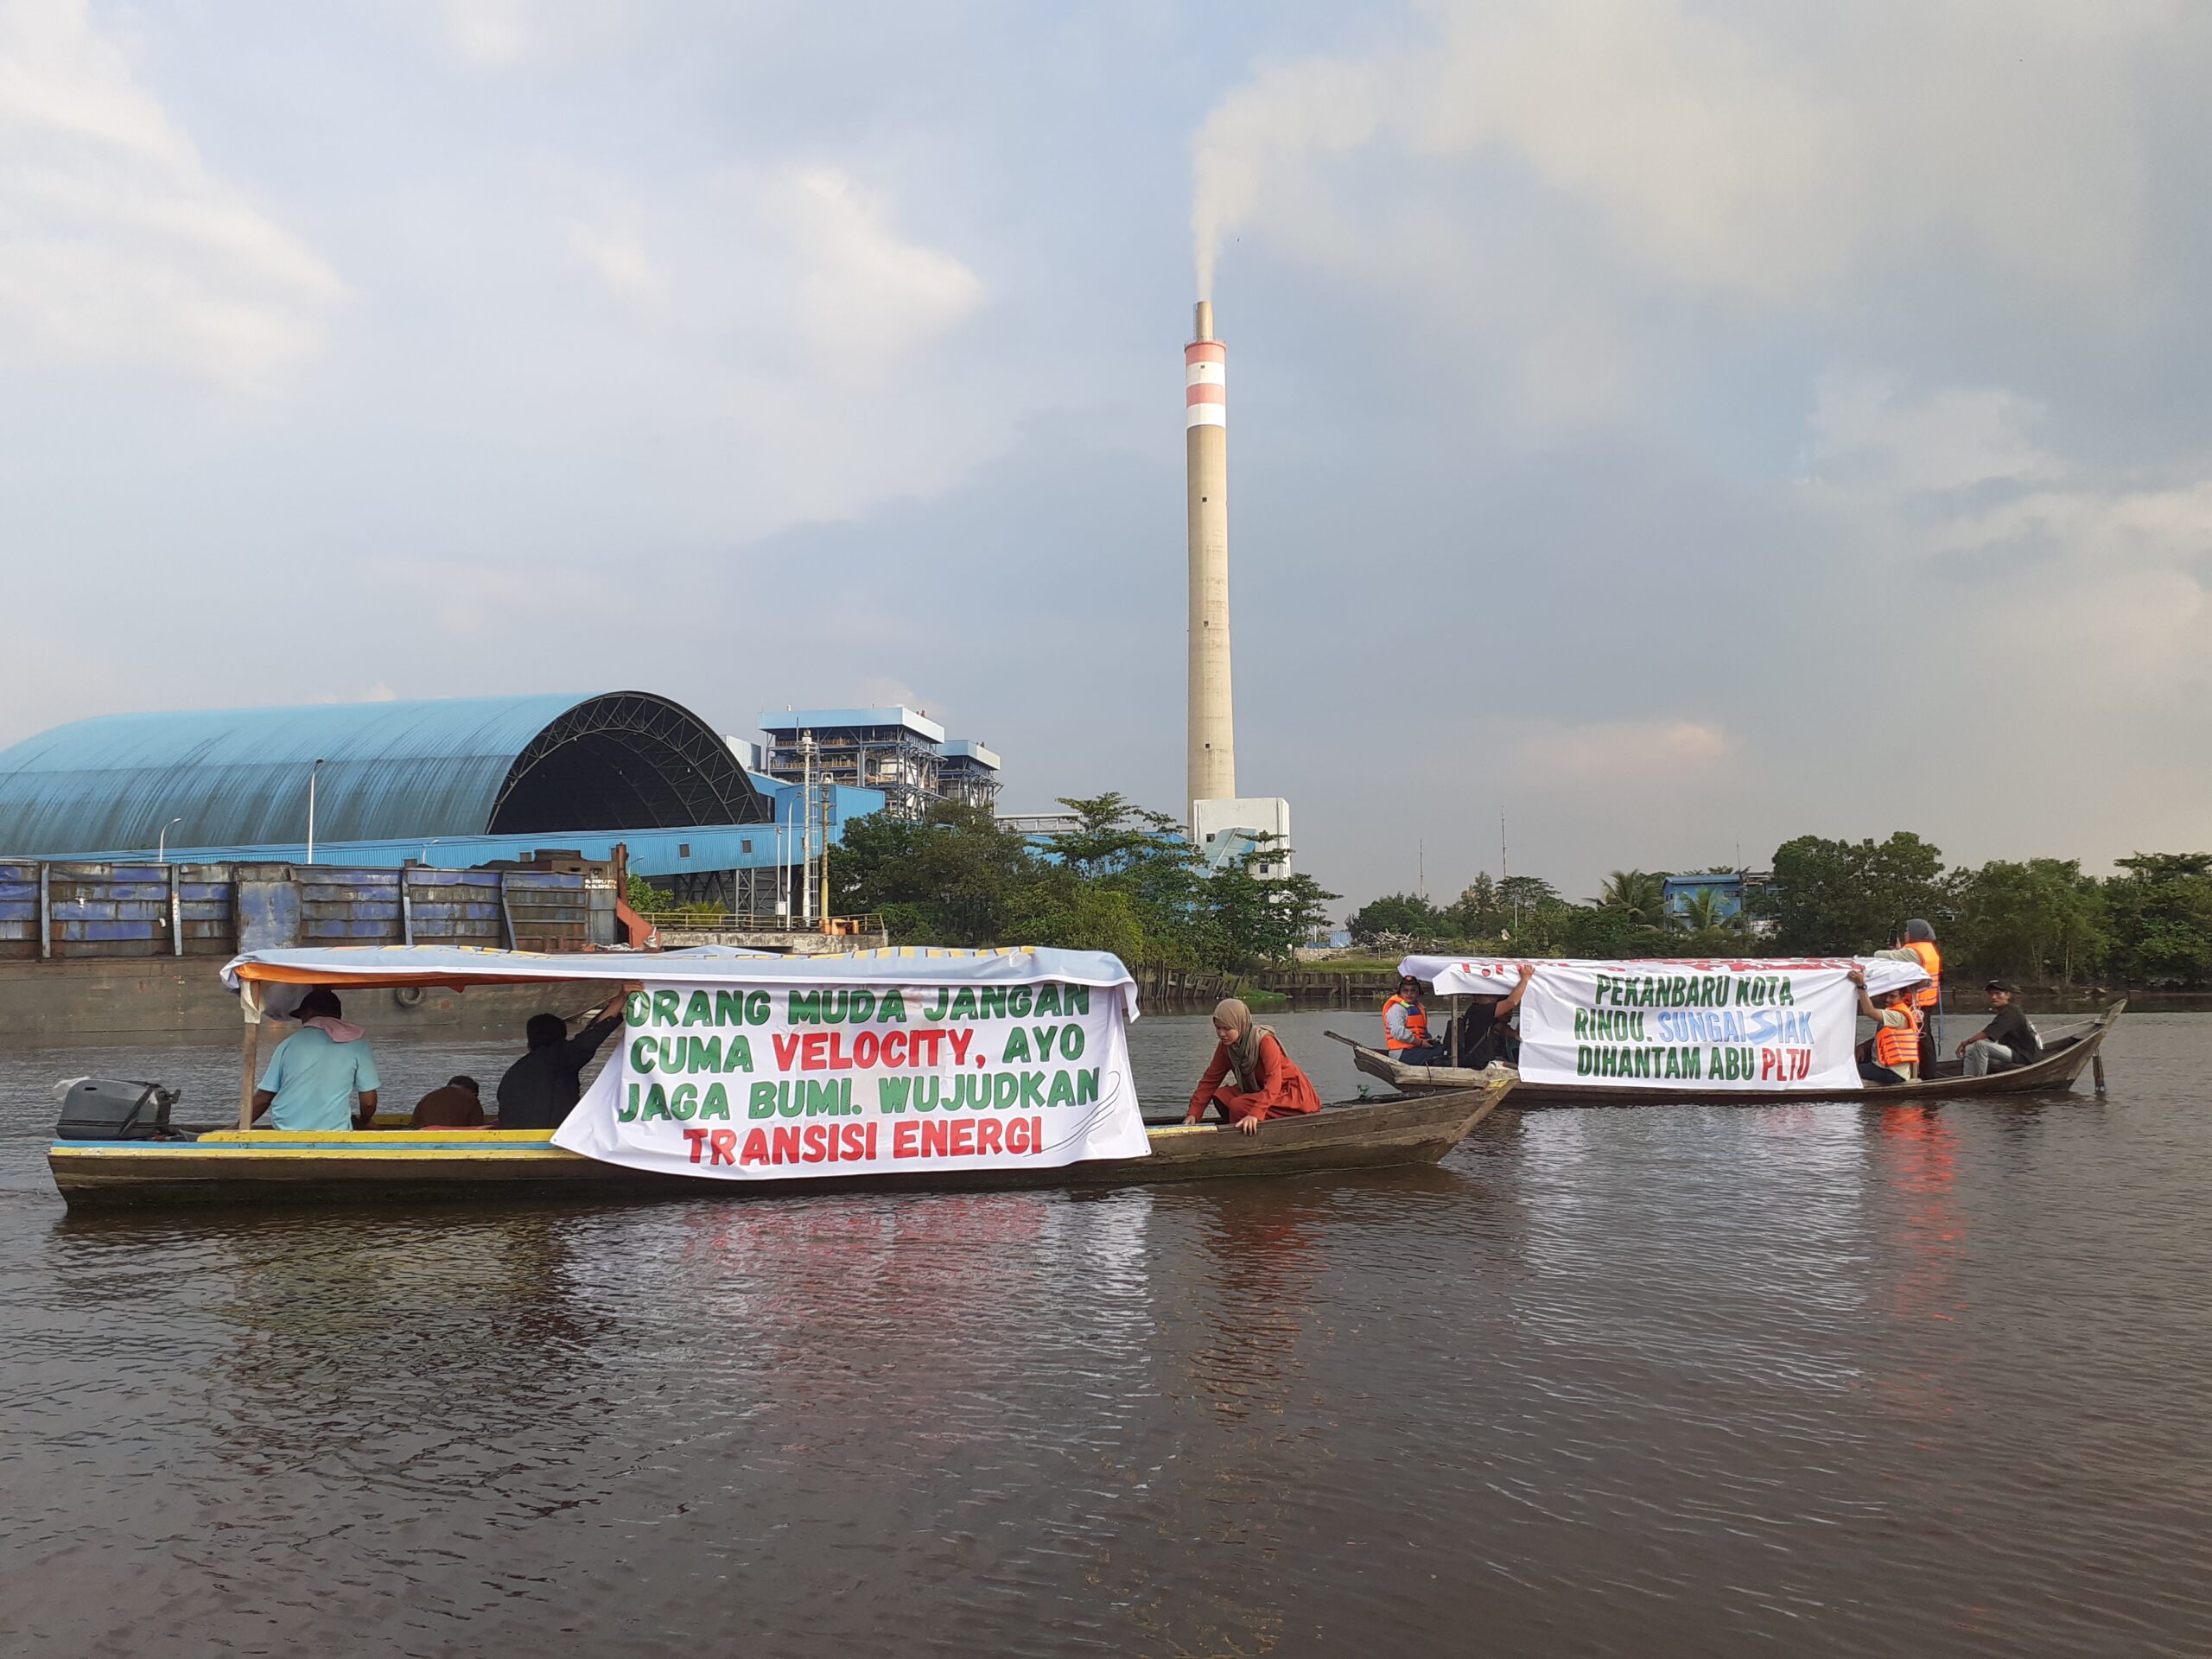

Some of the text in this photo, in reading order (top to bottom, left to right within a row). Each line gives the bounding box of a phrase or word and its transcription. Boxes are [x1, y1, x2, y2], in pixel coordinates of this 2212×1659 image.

[626, 983, 1090, 1028] ORANG MUDA JANGAN
[1595, 974, 1795, 1007] PEKANBARU KOTA
[630, 1023, 1085, 1074] CUMA VELOCITY, AYO
[1573, 1007, 1815, 1045] RINDU. SUNGAI SIAK
[1576, 1044, 1812, 1082] DIHANTAM ABU PLTU
[619, 1067, 1100, 1123] JAGA BUMI. WUJUDKAN
[683, 1116, 1043, 1166] TRANSISI ENERGI
